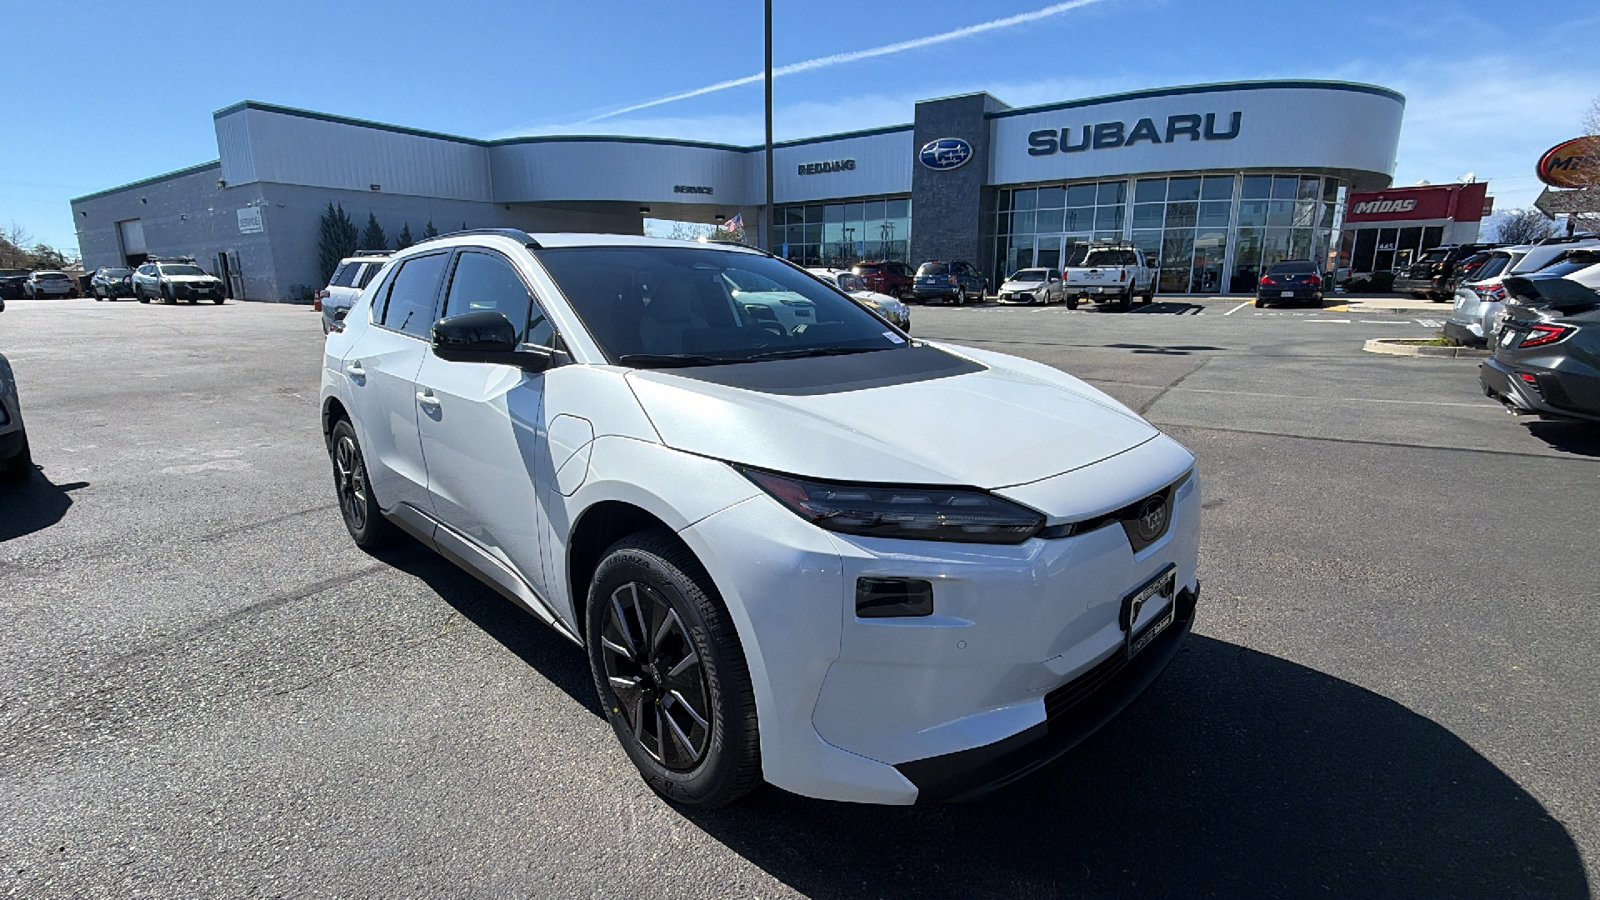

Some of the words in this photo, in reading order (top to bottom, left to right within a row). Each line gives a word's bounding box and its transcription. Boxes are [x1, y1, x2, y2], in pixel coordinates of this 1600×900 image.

[1028, 112, 1242, 156] SUBARU
[798, 159, 856, 175] REDDING
[673, 185, 714, 195] SERVICE
[240, 217, 259, 227] SERVICE
